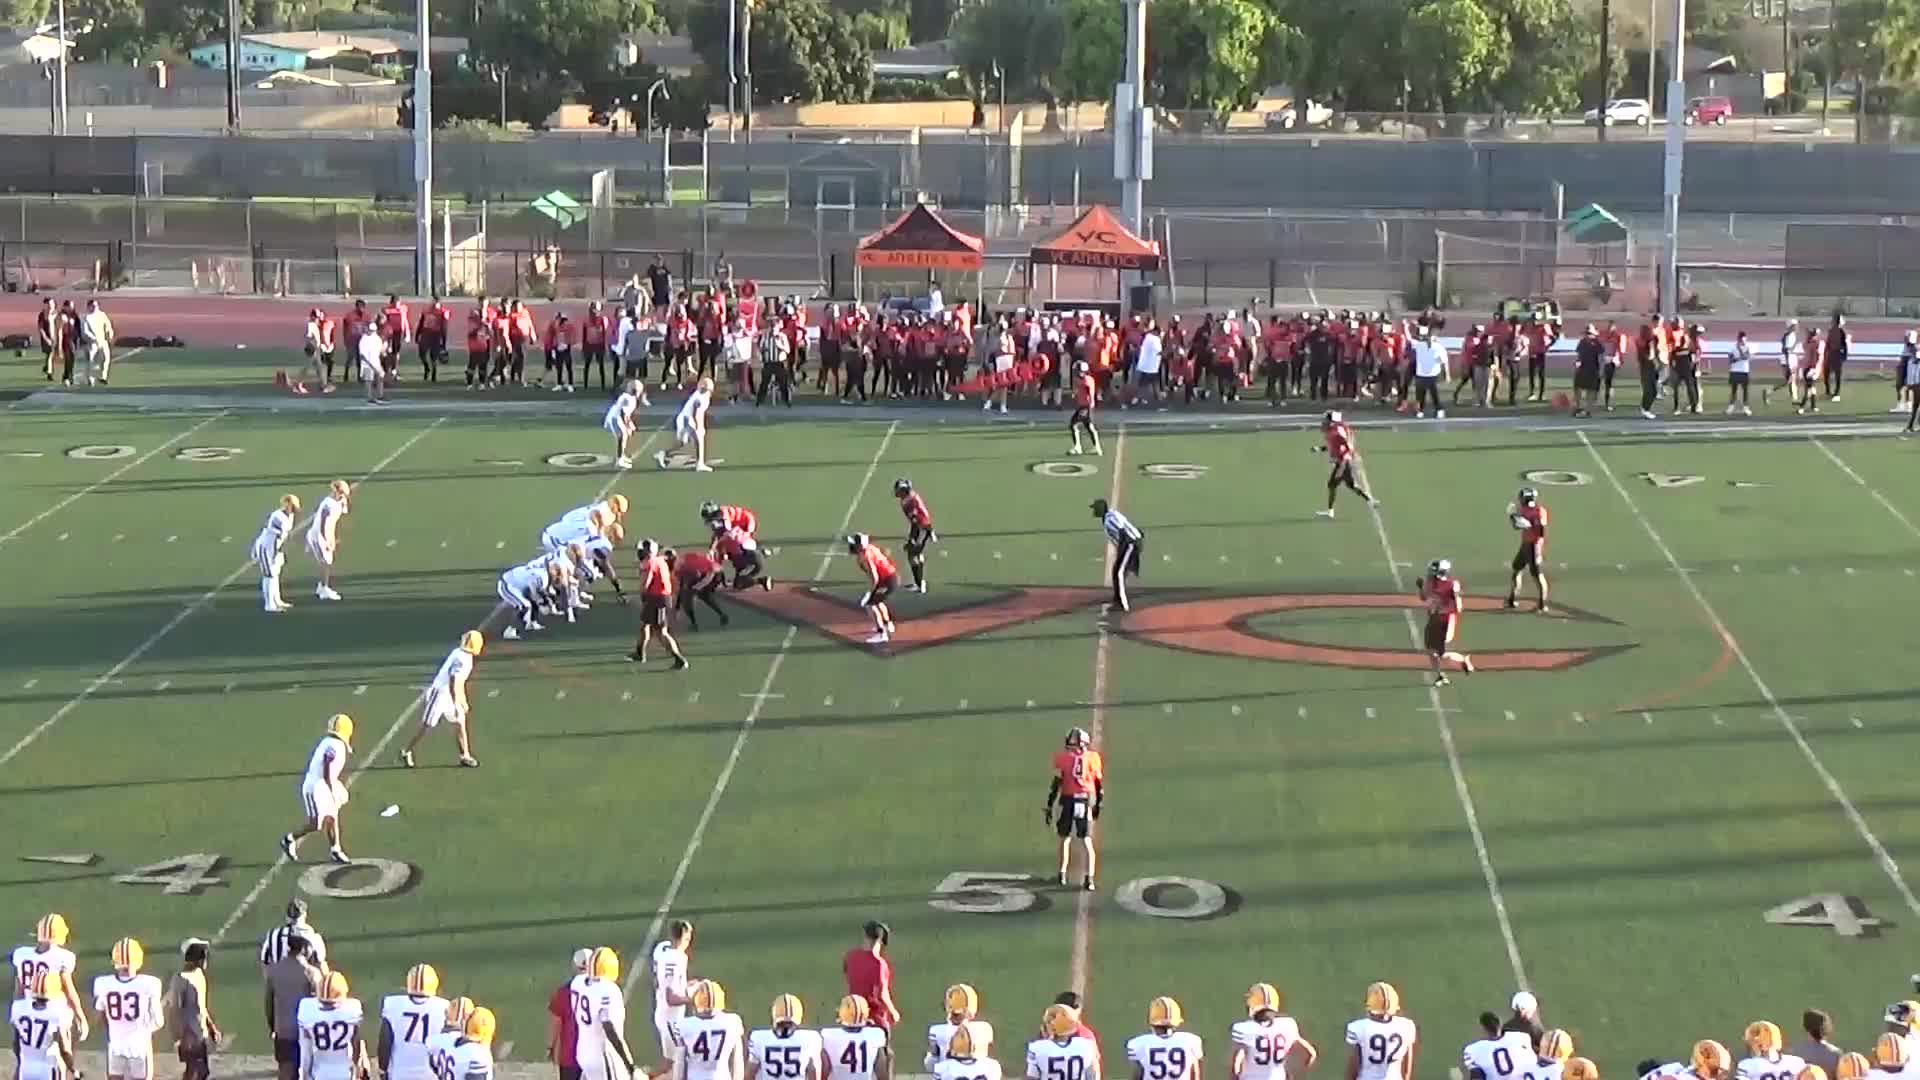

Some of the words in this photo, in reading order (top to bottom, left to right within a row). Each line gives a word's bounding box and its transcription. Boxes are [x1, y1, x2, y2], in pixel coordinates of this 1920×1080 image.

[1076, 230, 1116, 244] VC
[1071, 252, 1139, 267] ATHLETICS
[107, 991, 140, 1021] 83
[570, 990, 592, 1025] 79
[19, 1015, 49, 1049] 37
[313, 1020, 349, 1051] 82
[402, 1011, 430, 1044] 71
[693, 1029, 727, 1062] 47
[840, 1039, 867, 1073] 41
[1368, 1032, 1403, 1065] 92
[1492, 1047, 1514, 1076] 0
[765, 1046, 801, 1078] 55
[1047, 1055, 1084, 1080] 50
[1149, 1047, 1187, 1079] 59
